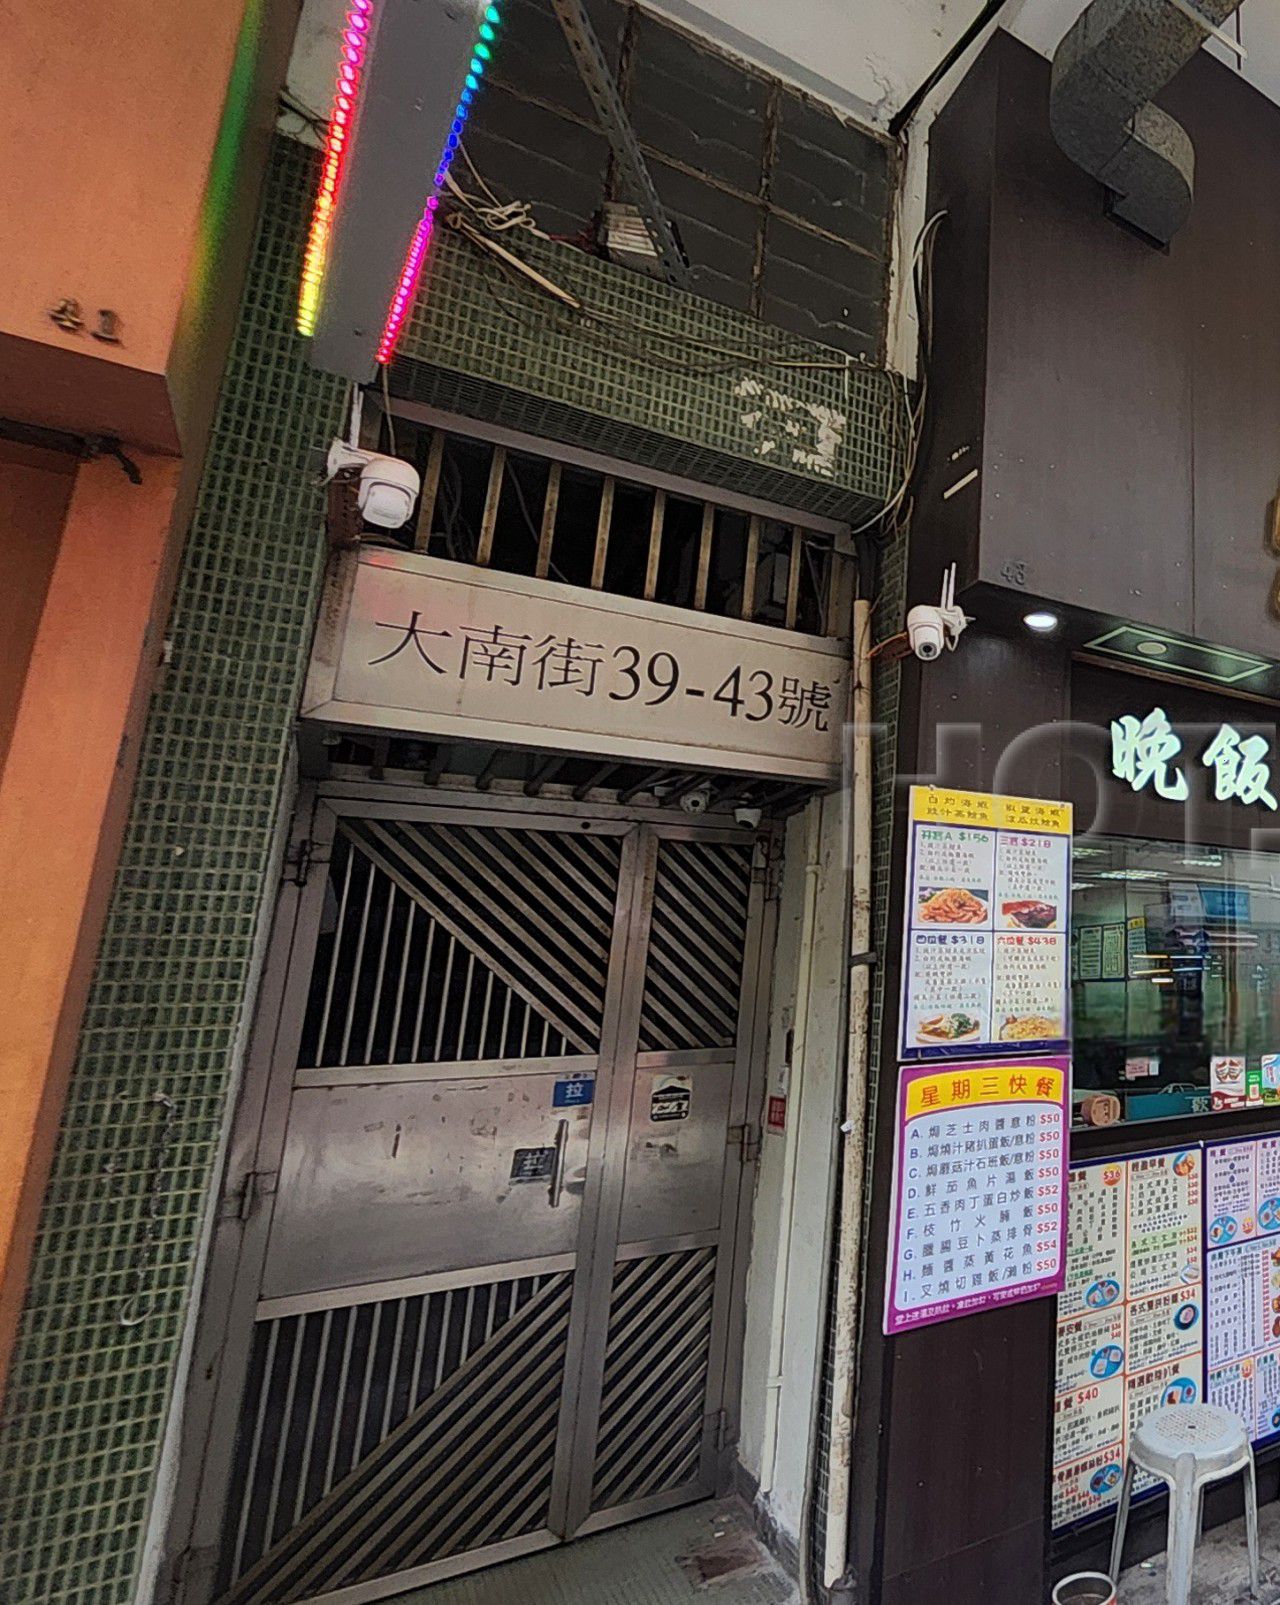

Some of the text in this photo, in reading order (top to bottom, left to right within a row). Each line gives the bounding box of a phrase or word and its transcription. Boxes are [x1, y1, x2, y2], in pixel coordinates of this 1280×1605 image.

[367, 610, 832, 732] 大南街39-43號
[1110, 706, 1279, 812] 晚飯
[1020, 836, 1052, 848] $218
[951, 935, 986, 945] $318
[565, 1082, 584, 1099] 拉
[921, 1073, 1055, 1108] 星期三快餐
[1040, 1113, 1061, 1125] $50
[1039, 1131, 1060, 1143] $50
[1039, 1148, 1060, 1160] $50
[1038, 1166, 1060, 1178] $50
[924, 1186, 1034, 1217] 五香肉丁蛋白炒飯
[1037, 1184, 1059, 1197] $52
[1037, 1203, 1059, 1215] $50
[1036, 1221, 1058, 1234] $52
[1036, 1239, 1057, 1253] $54
[1036, 1258, 1057, 1272] $50
[1077, 1387, 1099, 1404] $40
